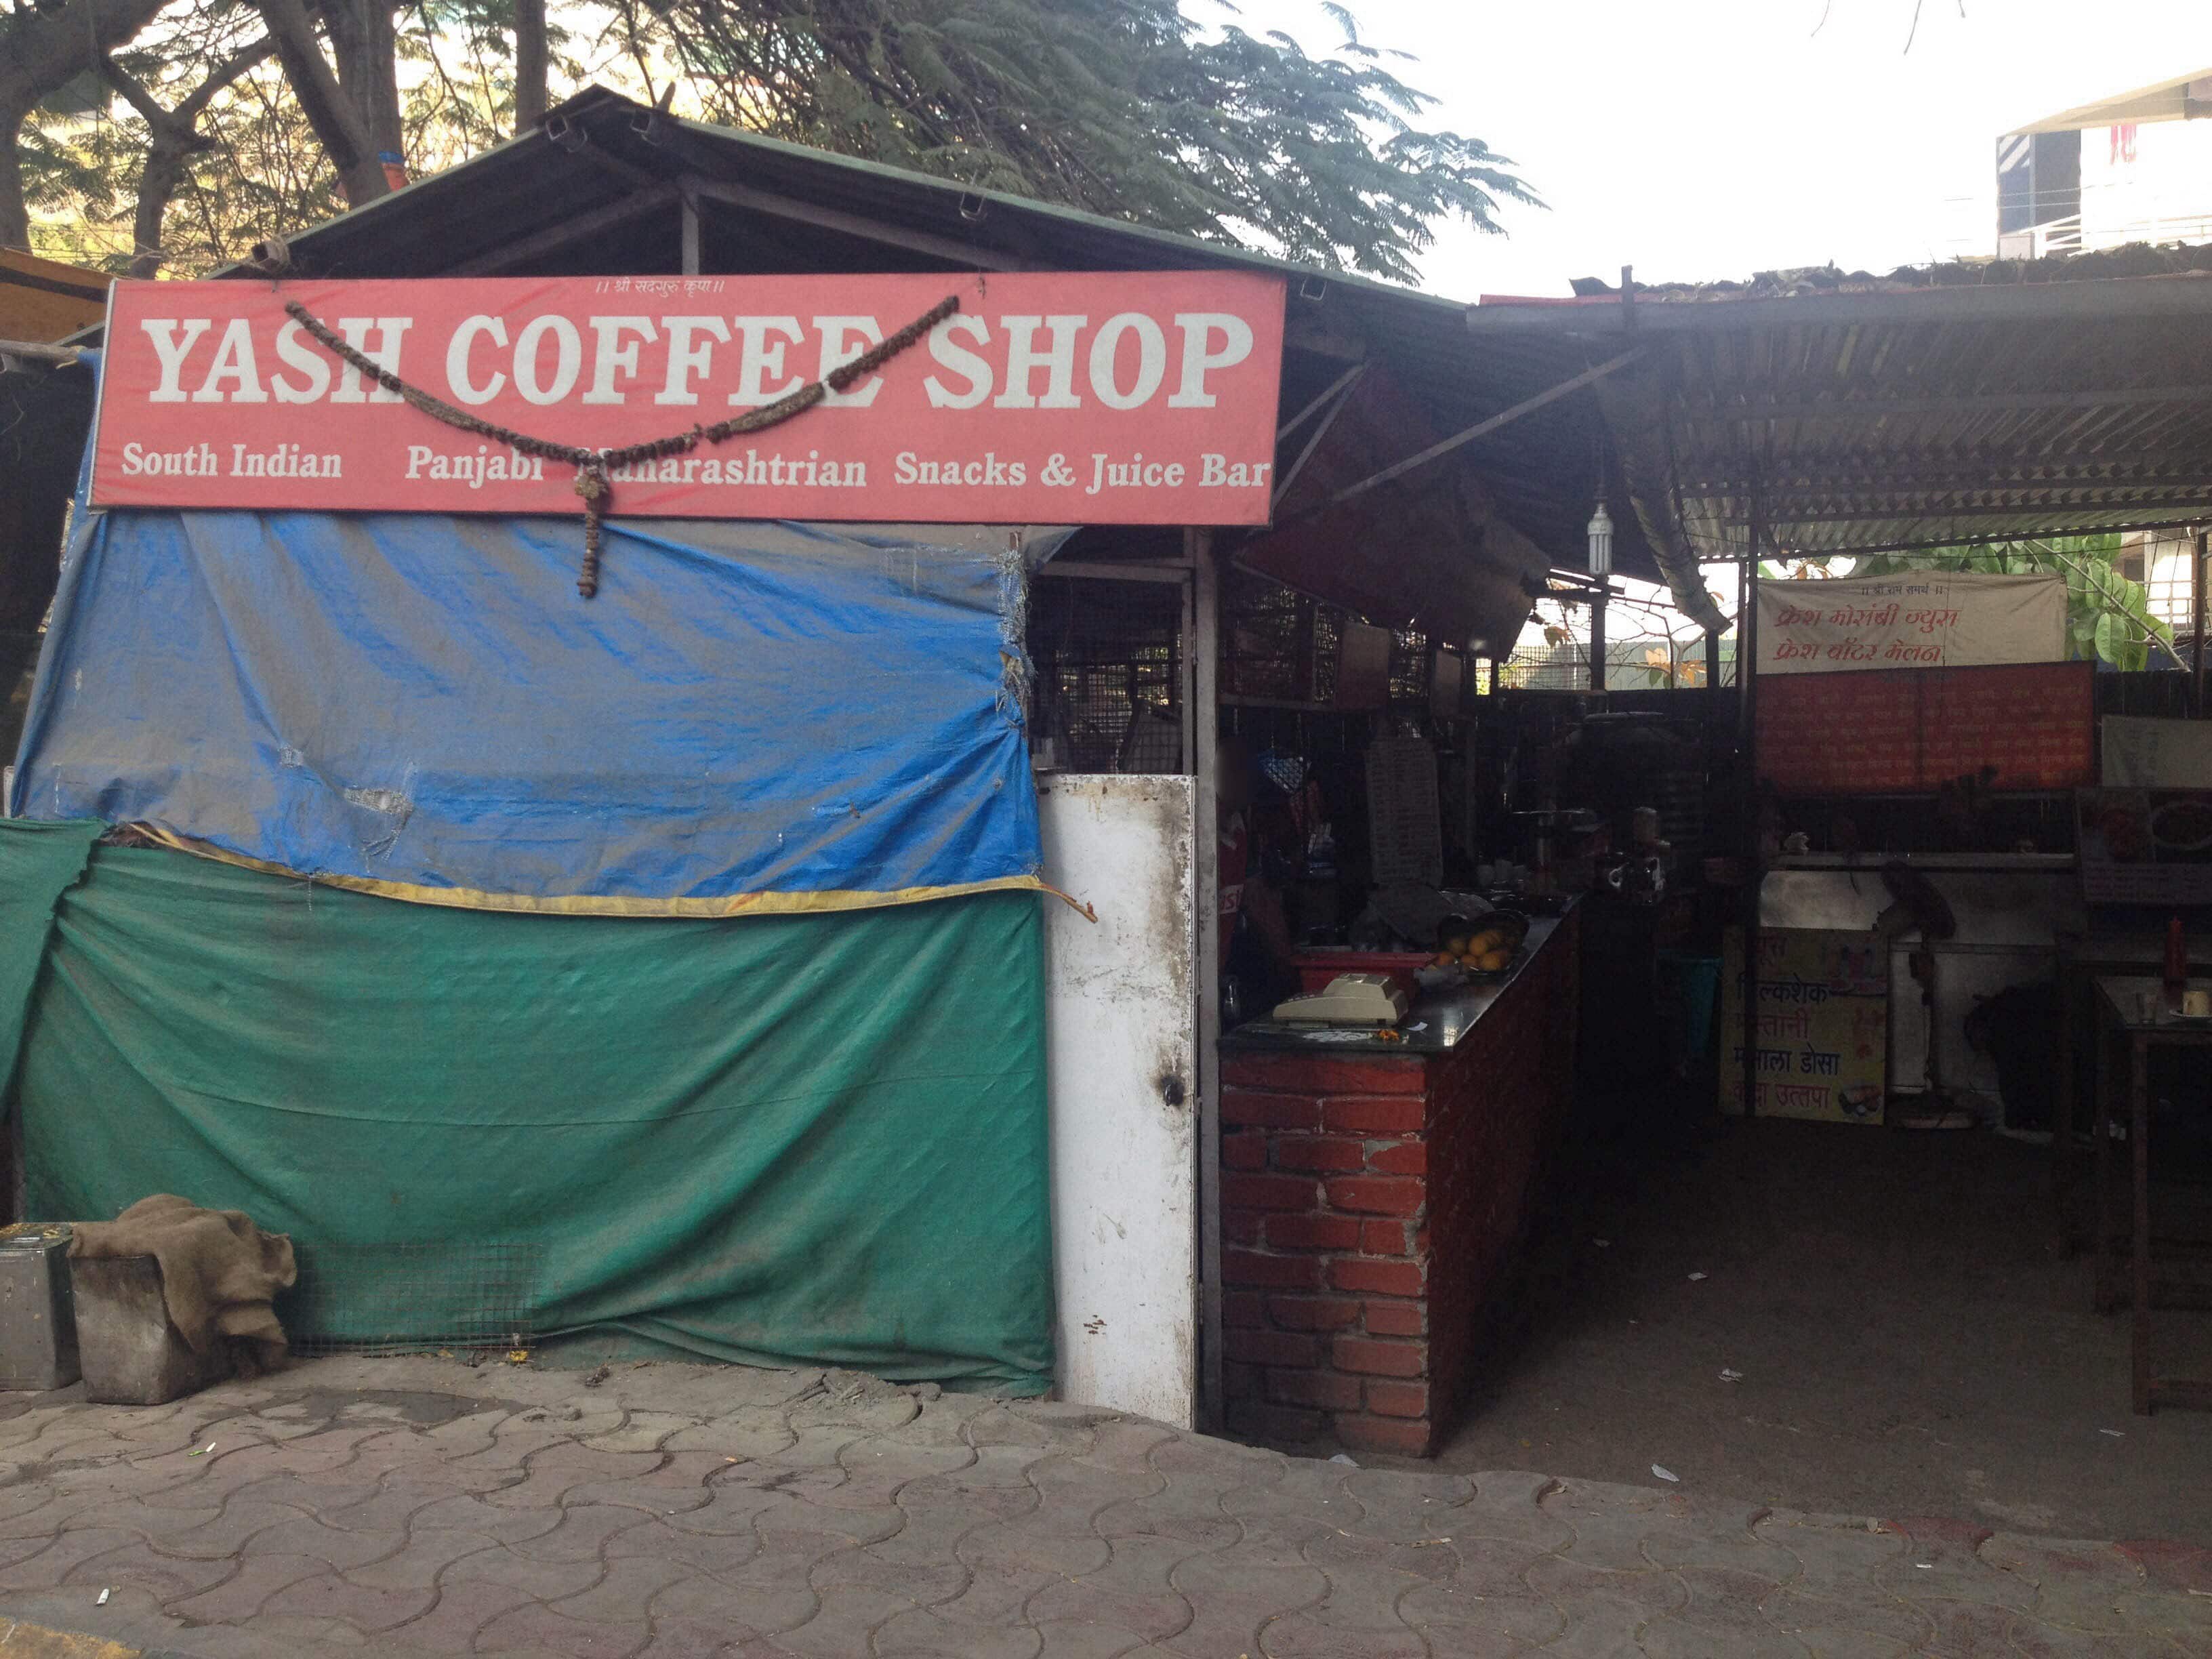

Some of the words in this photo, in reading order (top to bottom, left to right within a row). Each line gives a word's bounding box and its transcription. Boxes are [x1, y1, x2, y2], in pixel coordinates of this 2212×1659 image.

[141, 316, 413, 405] YASH
[446, 314, 884, 407] COFFEE
[922, 311, 1254, 410] SHOP
[121, 442, 218, 478] South
[229, 442, 343, 478] Indian
[405, 445, 544, 489] Panjabi
[894, 452, 1027, 488] Snacks
[1040, 453, 1077, 486] &
[1086, 453, 1185, 495] Juice
[1198, 454, 1273, 489] Bar
[1799, 1042, 1841, 1076] डोसा
